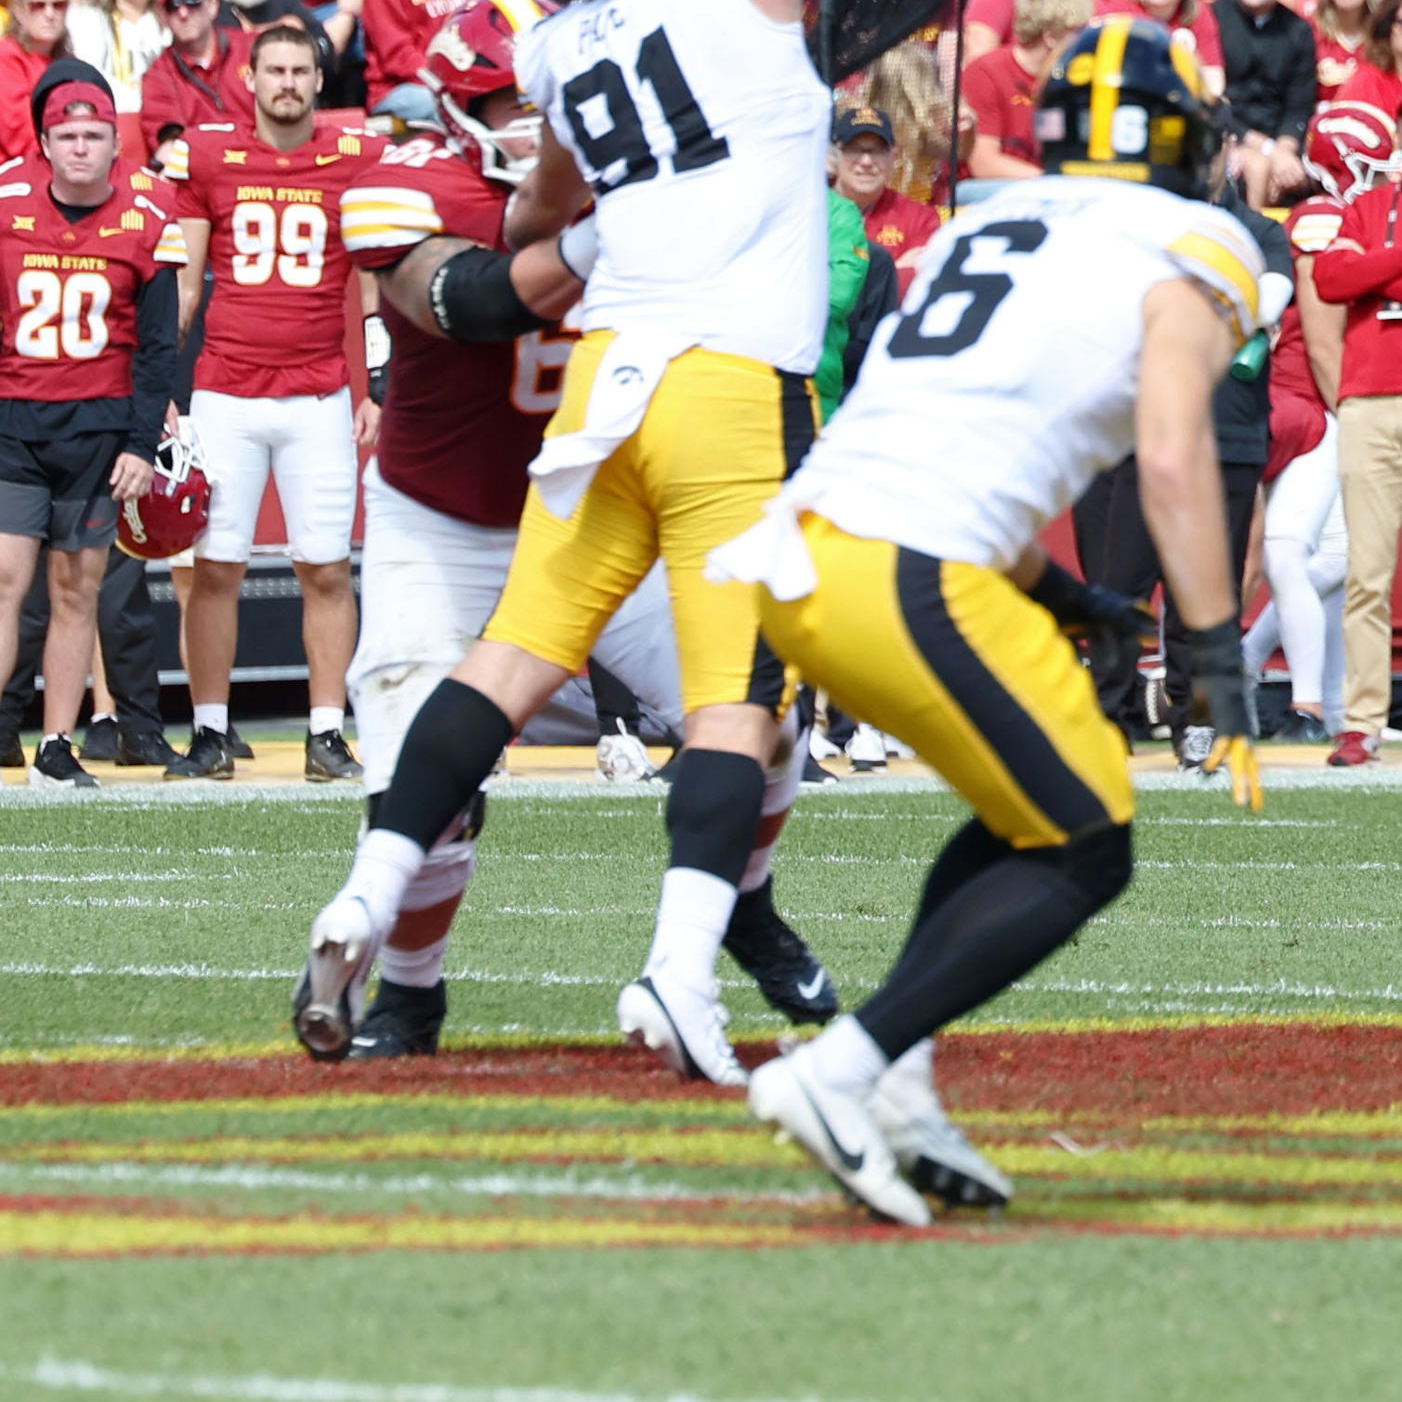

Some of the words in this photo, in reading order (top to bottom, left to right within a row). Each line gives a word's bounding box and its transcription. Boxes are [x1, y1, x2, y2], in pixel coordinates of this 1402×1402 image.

[562, 24, 732, 199] 91
[236, 185, 274, 201] IOWA
[275, 187, 323, 203] STATE
[23, 254, 59, 269] IOWA
[61, 255, 107, 271] STATE
[231, 201, 329, 288] 99
[15, 269, 112, 360] 20
[886, 219, 1049, 360] 6
